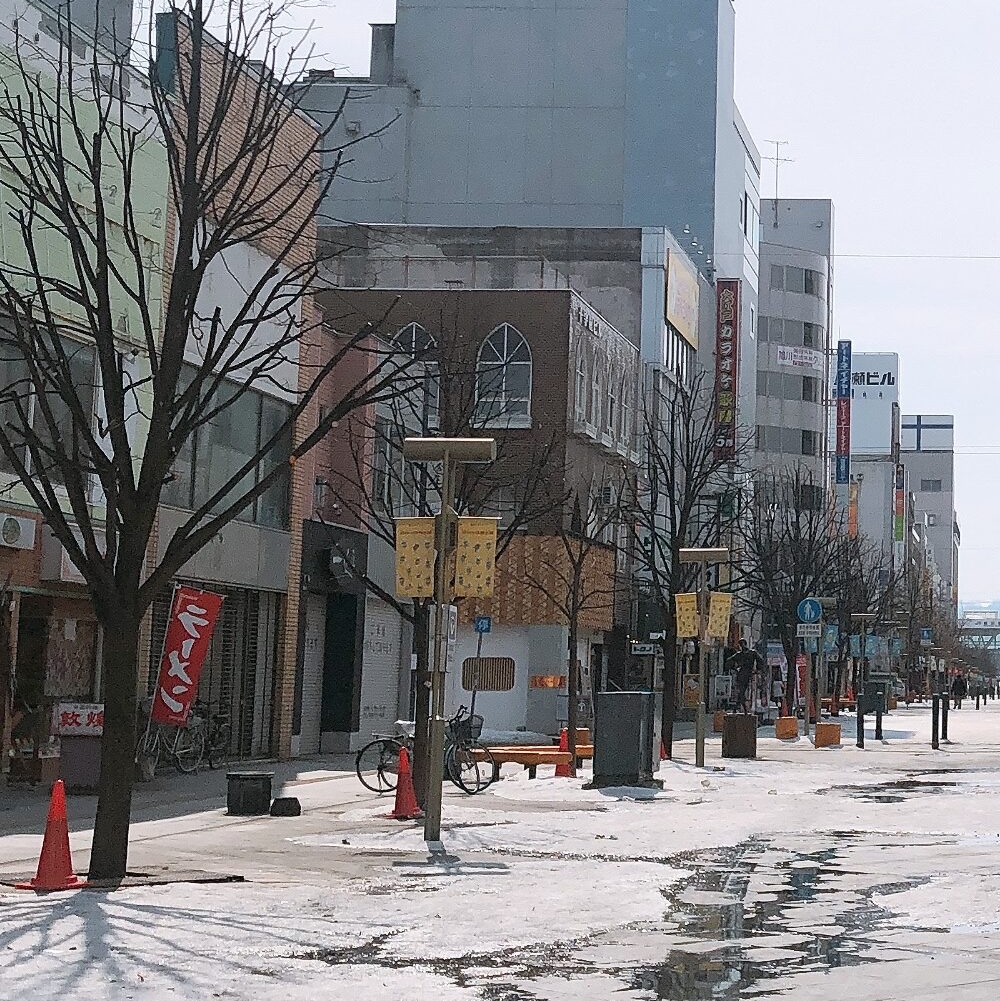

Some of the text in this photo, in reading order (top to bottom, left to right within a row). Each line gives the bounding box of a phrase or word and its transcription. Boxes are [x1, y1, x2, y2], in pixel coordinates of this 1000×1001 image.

[834, 372, 895, 386] 瀬ビル
[160, 604, 210, 713] ラーメン
